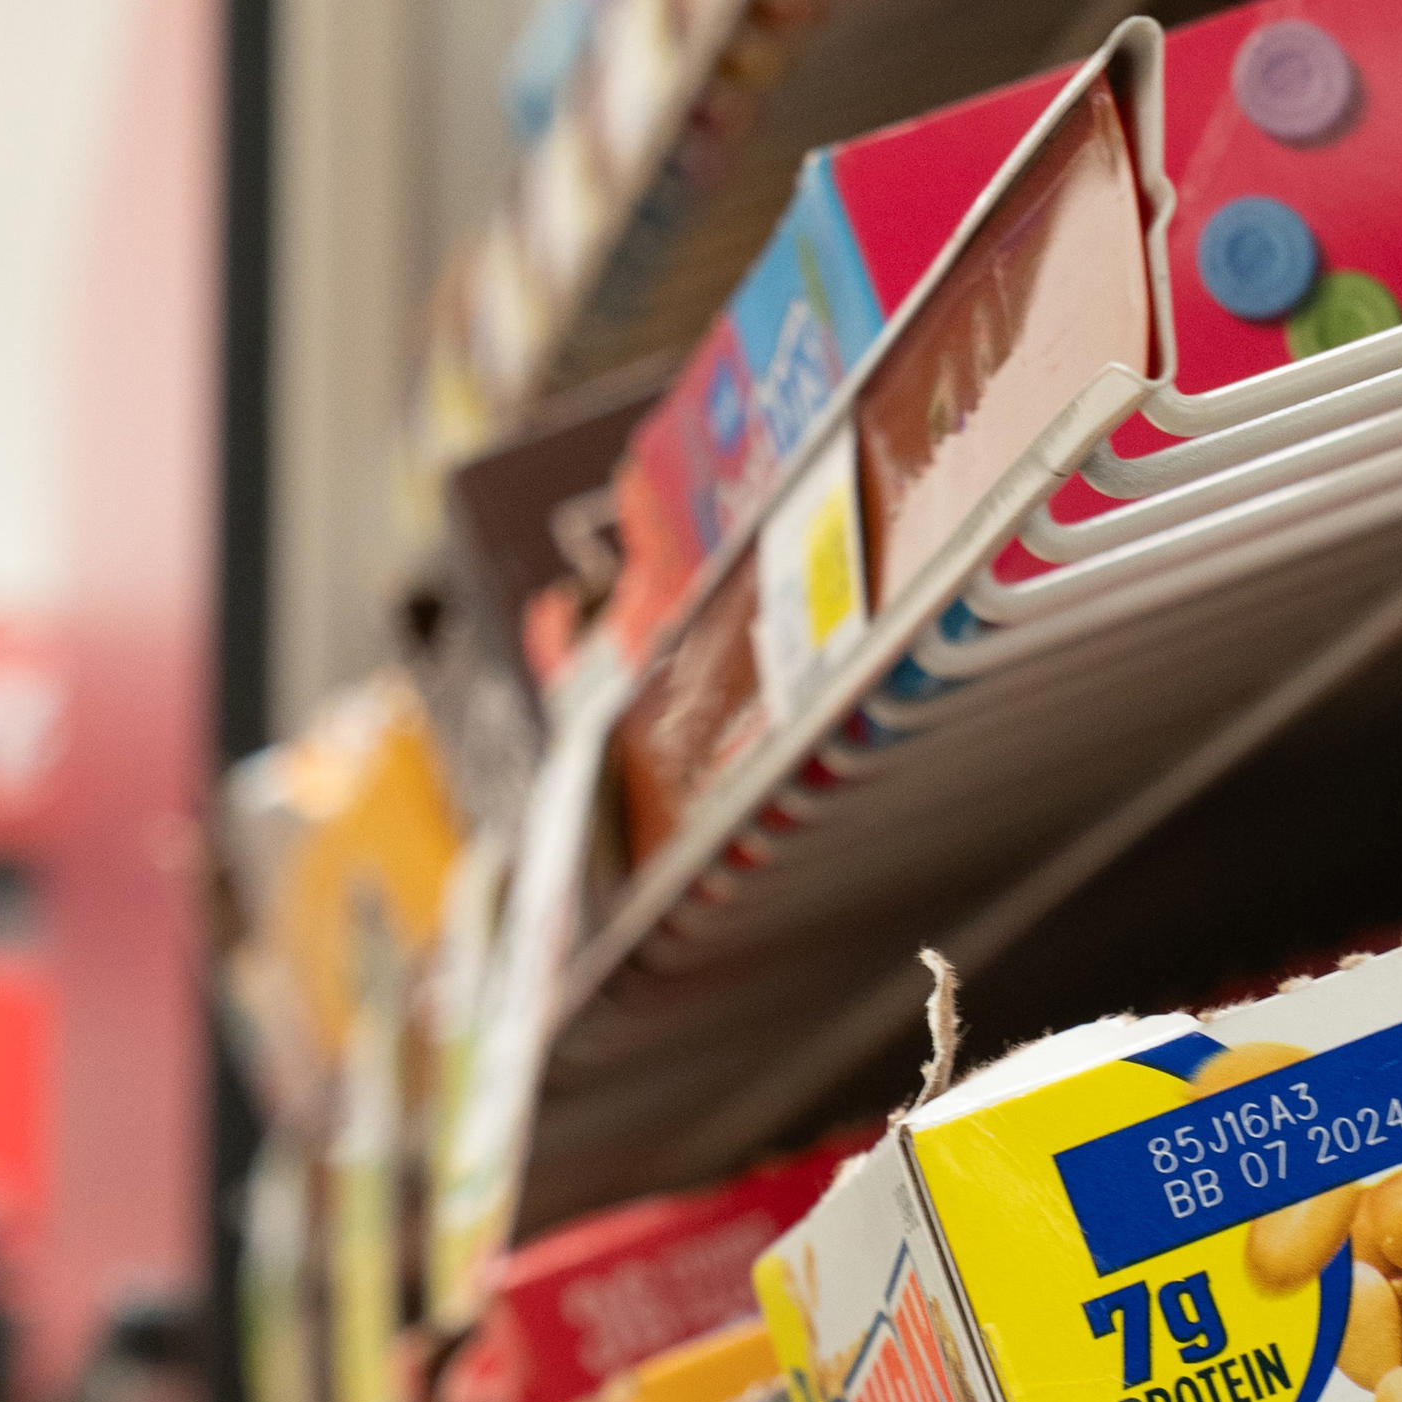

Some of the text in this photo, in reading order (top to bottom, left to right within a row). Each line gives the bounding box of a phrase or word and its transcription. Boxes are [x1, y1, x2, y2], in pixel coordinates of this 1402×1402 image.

[1147, 1081, 1319, 1174] 85J16A3
[1162, 1167, 1224, 1219] BB
[1238, 1139, 1287, 1189] 07
[1080, 1269, 1229, 1390] 7g
